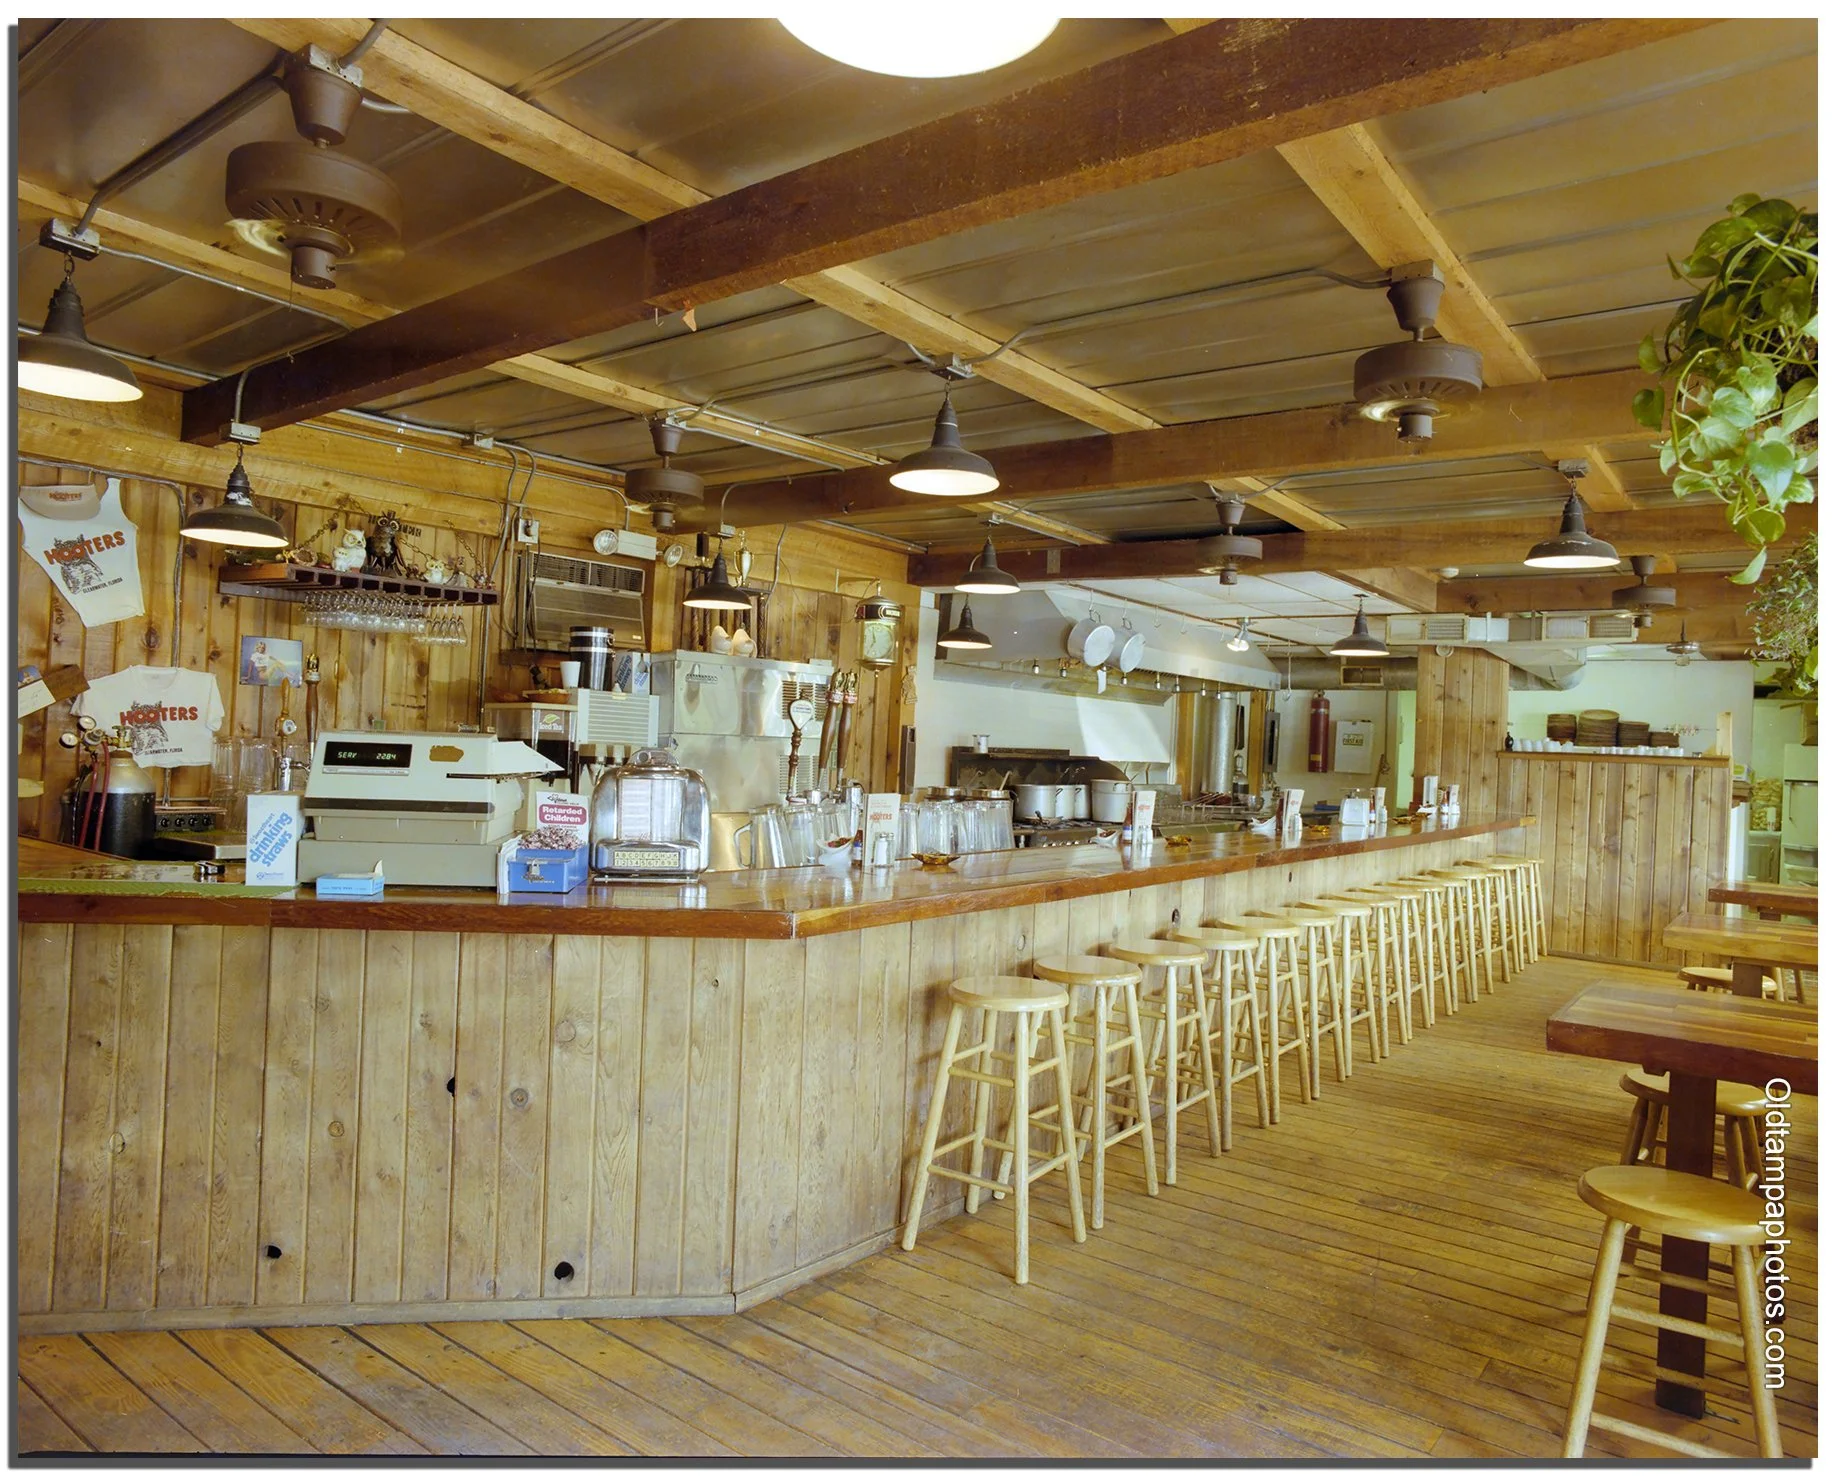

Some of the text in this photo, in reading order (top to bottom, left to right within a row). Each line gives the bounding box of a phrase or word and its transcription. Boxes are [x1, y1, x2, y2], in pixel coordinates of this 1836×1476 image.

[43, 531, 126, 565] HOOTERS
[120, 706, 199, 726] HOOTERS
[542, 805, 583, 815] Retarded
[544, 814, 581, 823] Children
[249, 811, 293, 862] drinking
[261, 830, 293, 867] straws
